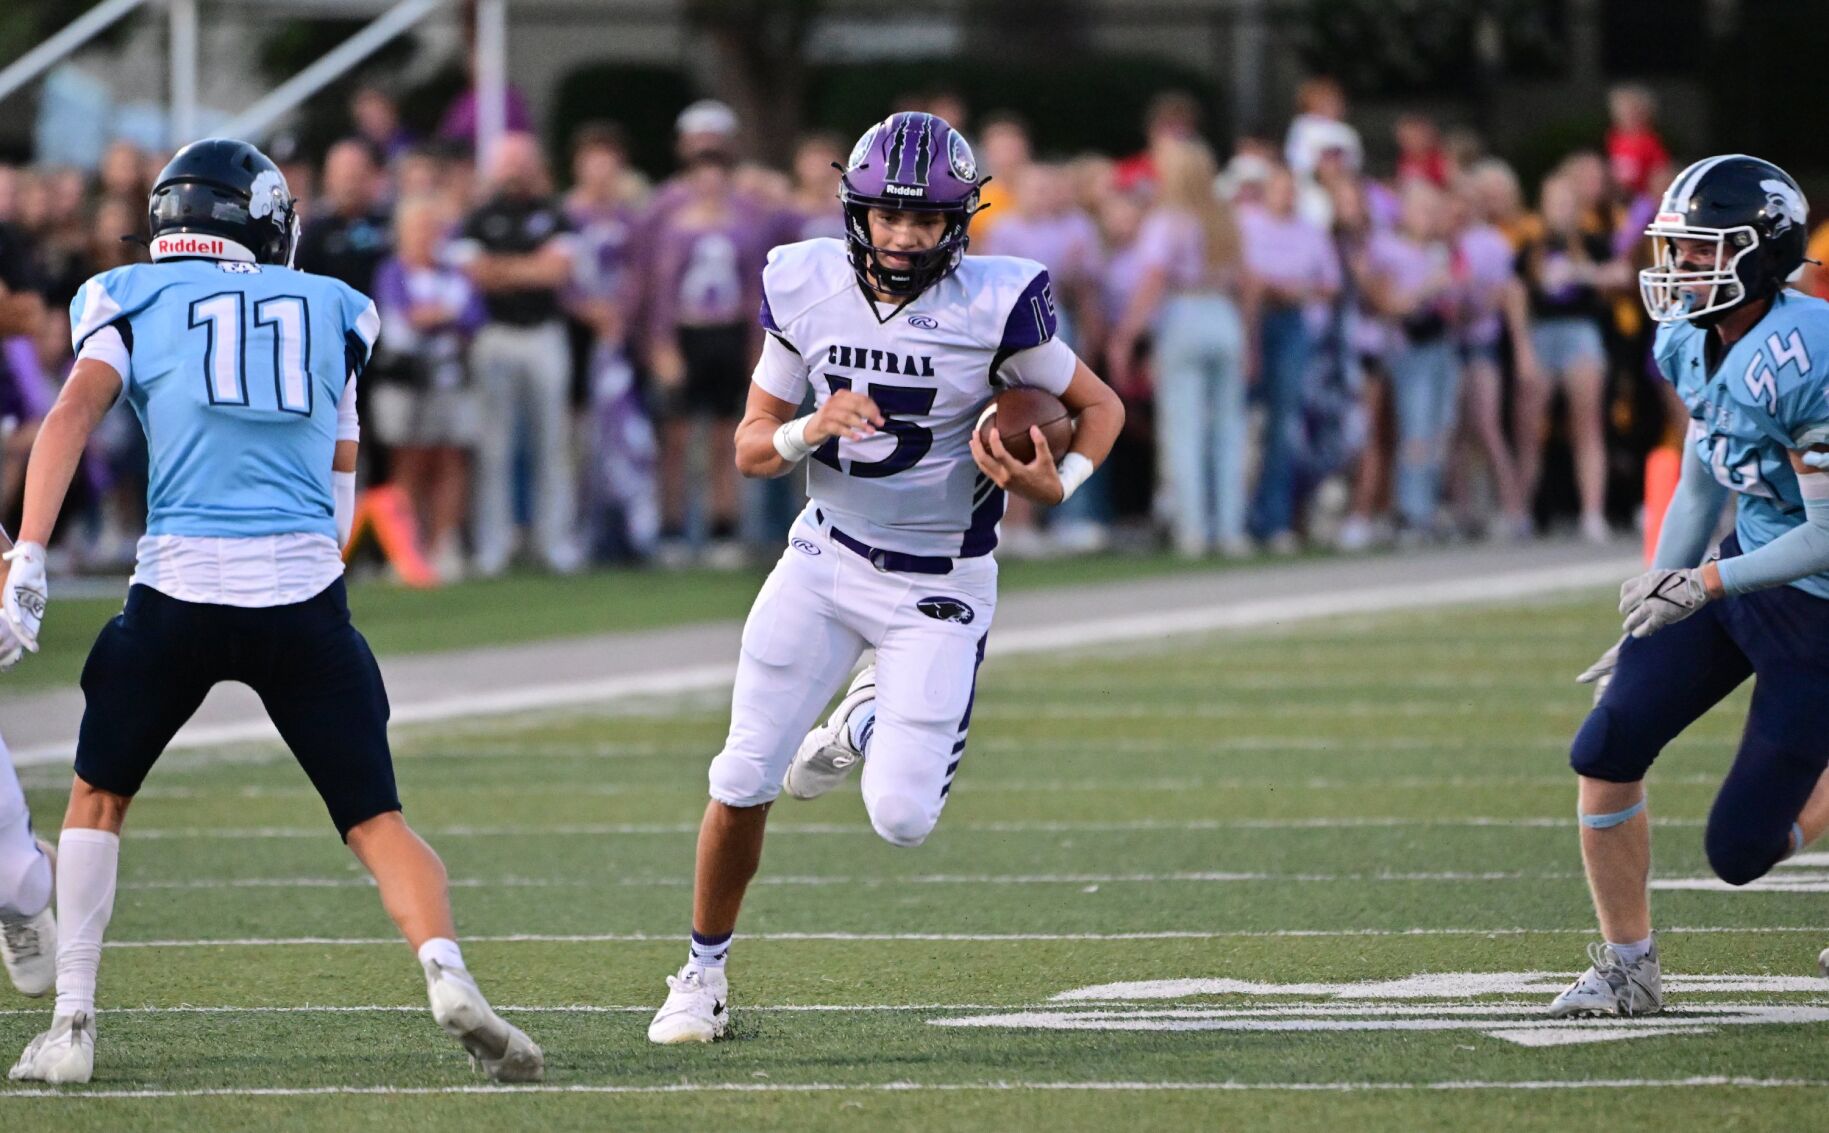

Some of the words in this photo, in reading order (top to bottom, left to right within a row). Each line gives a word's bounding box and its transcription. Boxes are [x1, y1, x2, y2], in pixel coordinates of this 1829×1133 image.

[885, 184, 924, 197] Riddell
[159, 239, 223, 255] Riddell
[188, 290, 313, 418] 11
[828, 345, 935, 378] CENTRAL
[1743, 326, 1813, 418] 54
